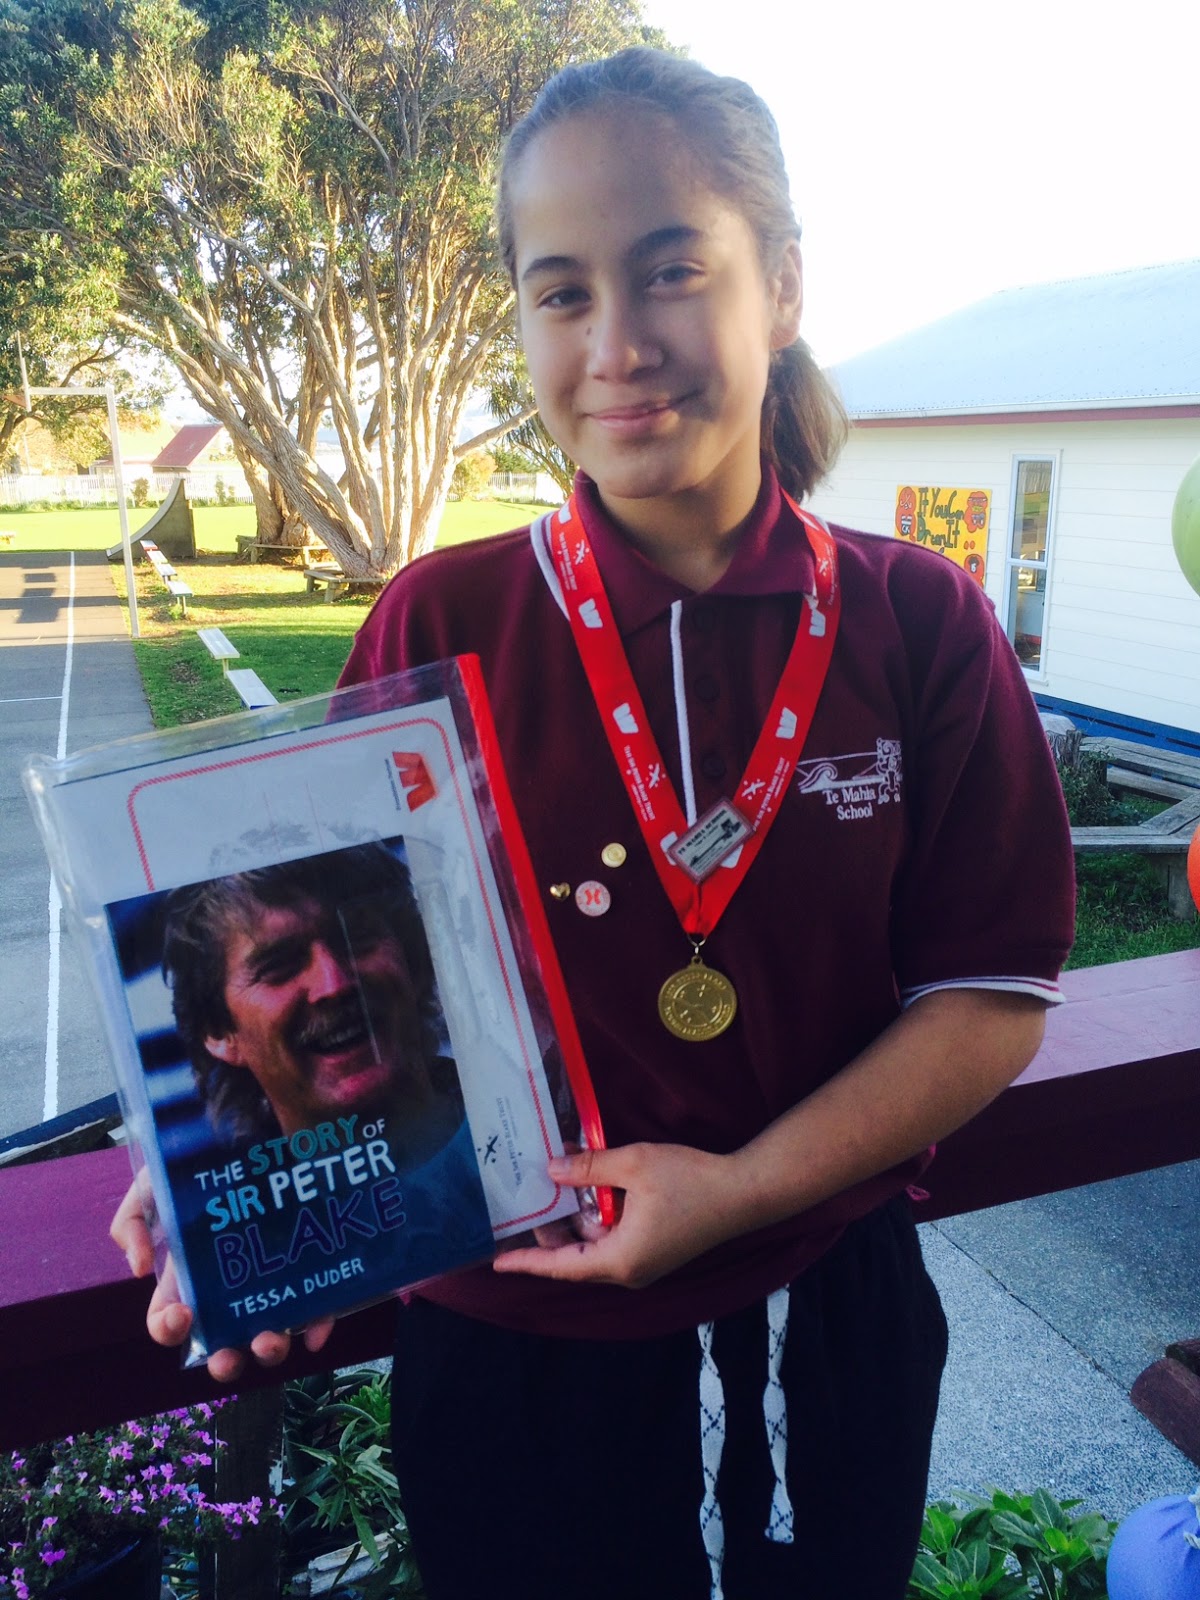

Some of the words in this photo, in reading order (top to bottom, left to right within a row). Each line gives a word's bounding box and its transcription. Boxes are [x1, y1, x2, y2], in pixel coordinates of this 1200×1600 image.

[822, 789, 839, 805] Te
[842, 786, 877, 803] Mahia
[836, 802, 873, 820] School
[194, 1160, 245, 1191] THE
[248, 1114, 359, 1175] STORY
[362, 1118, 386, 1139] OF
[205, 1185, 265, 1231] SIR
[268, 1140, 396, 1209] PETER
[214, 1176, 407, 1289] BLAKE
[229, 1285, 297, 1318] TESSA
[303, 1257, 365, 1294] DUDER
